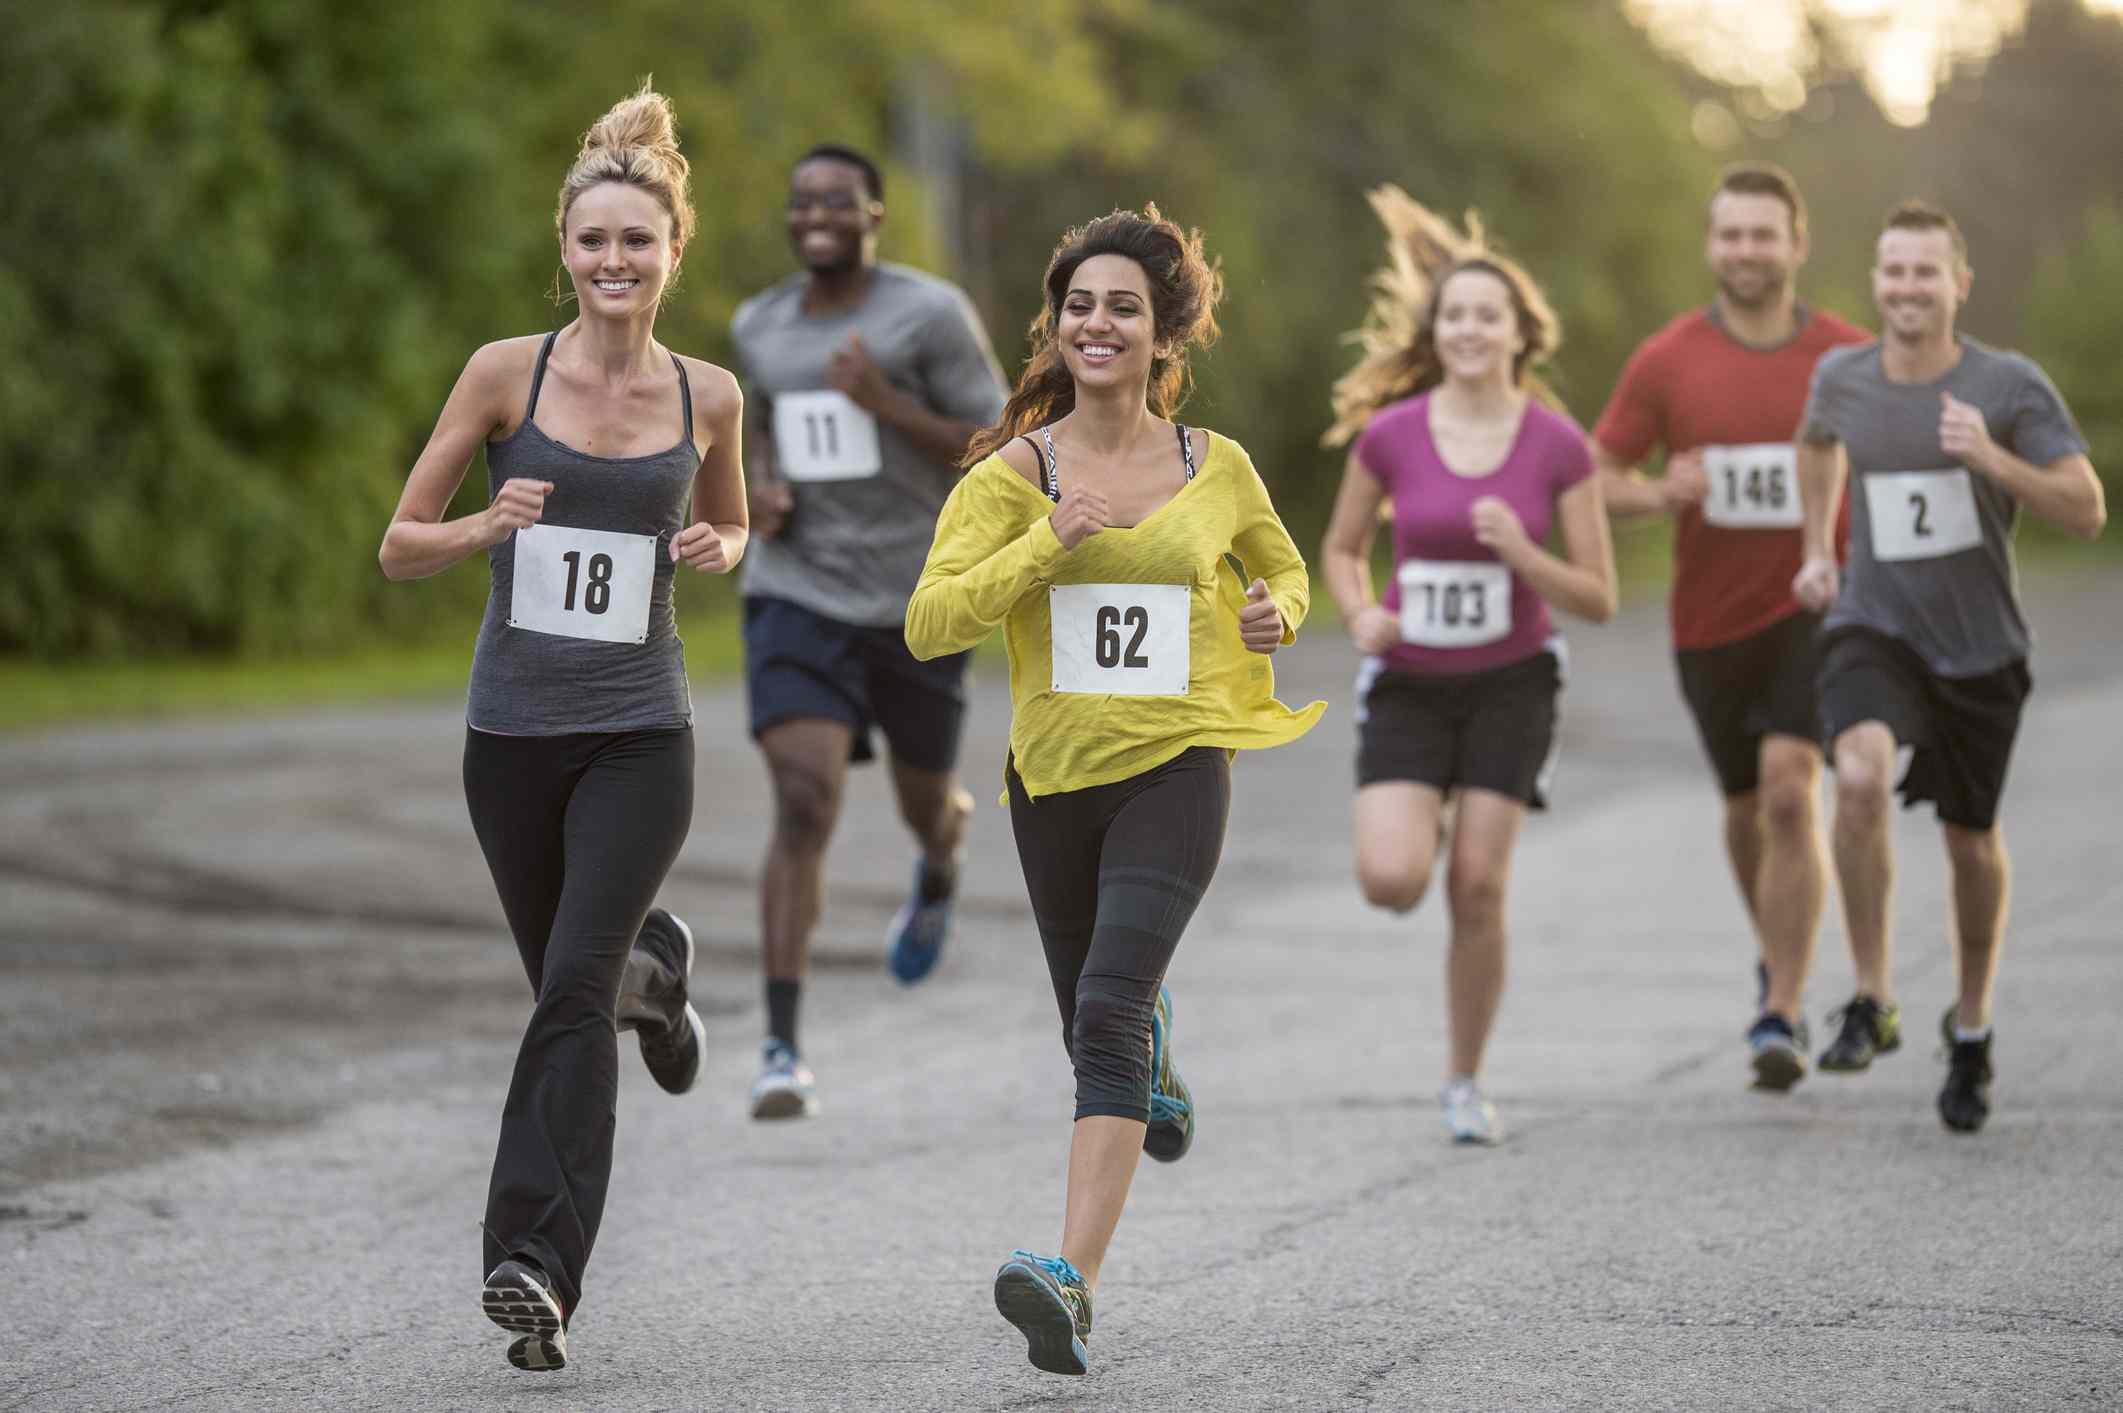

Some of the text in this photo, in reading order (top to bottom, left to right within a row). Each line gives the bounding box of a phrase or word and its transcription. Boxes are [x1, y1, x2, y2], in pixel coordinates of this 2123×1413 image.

[804, 412, 841, 458] 11
[1723, 464, 1788, 511] 146
[1908, 491, 1935, 539] 2
[562, 550, 613, 615] 18
[1421, 581, 1487, 629] 103
[1095, 605, 1149, 669] 62
